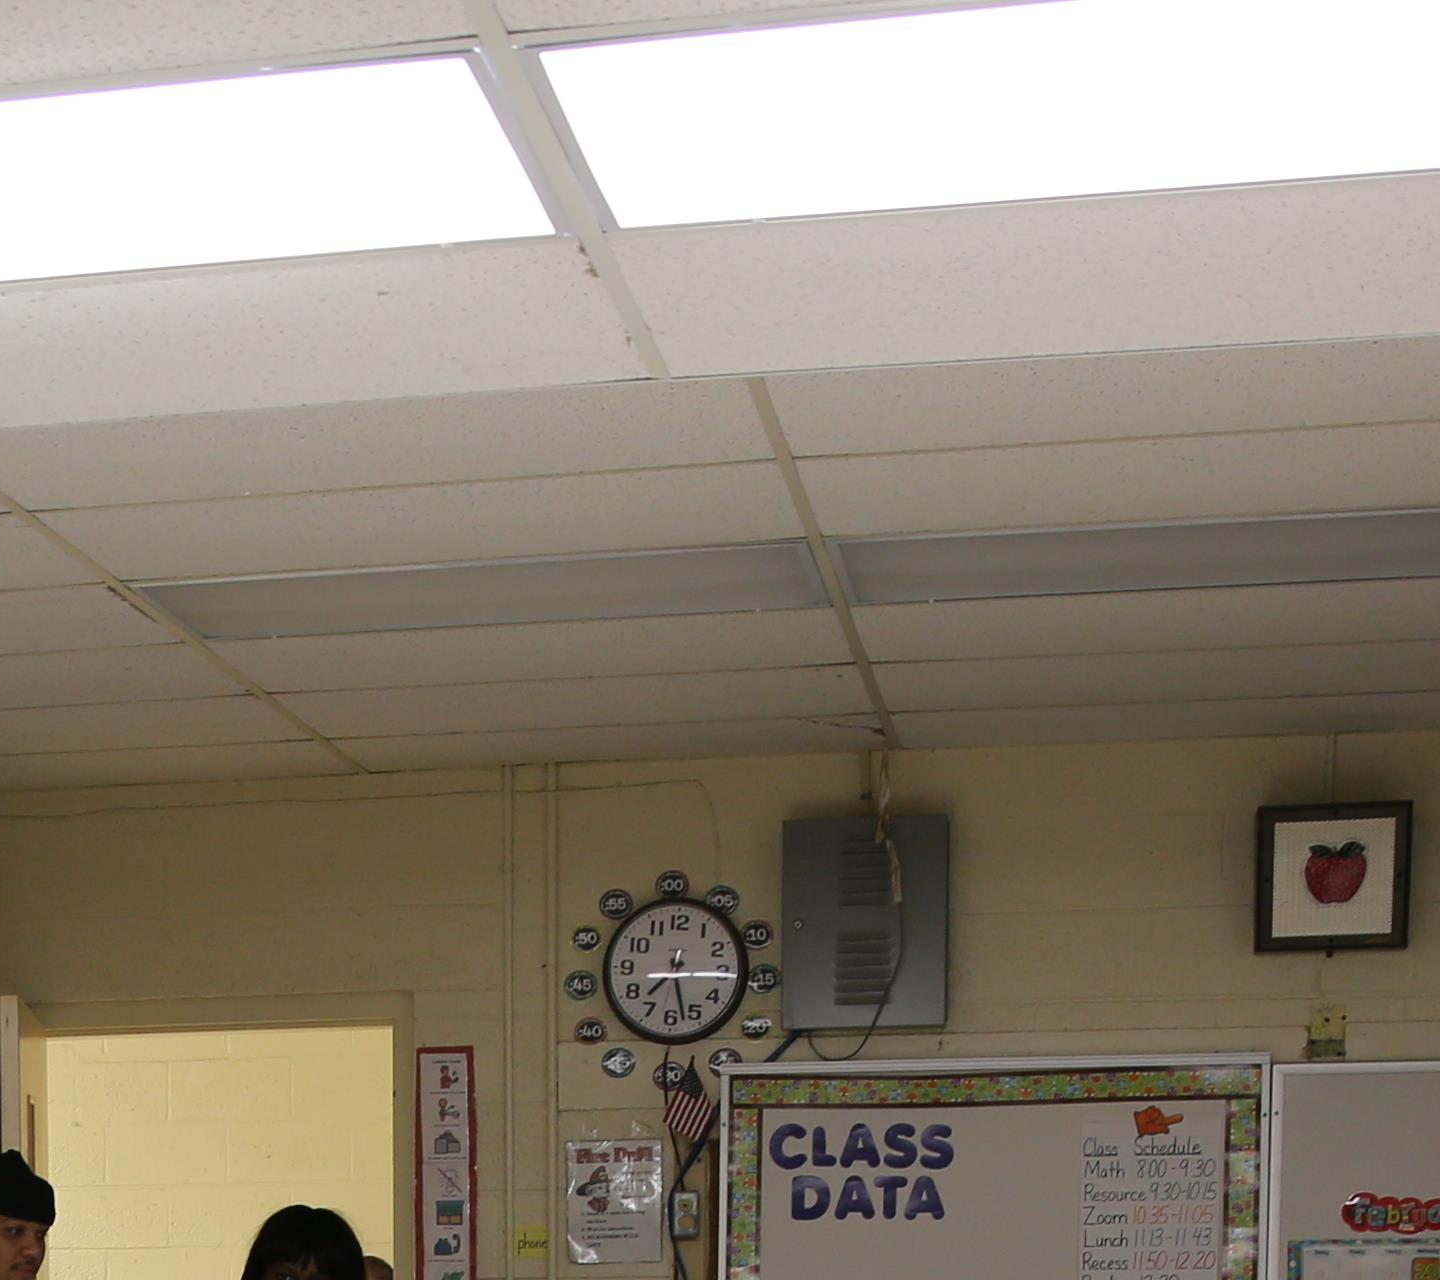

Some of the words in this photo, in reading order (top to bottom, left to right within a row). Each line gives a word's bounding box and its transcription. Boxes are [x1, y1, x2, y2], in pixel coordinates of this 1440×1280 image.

[660, 879, 682, 891] :00
[650, 920, 664, 936] 11
[670, 914, 690, 931] 12
[700, 922, 706, 938] 1
[630, 937, 650, 954] 10
[711, 941, 724, 957] 2
[620, 960, 634, 976] 9
[626, 984, 640, 999] 8
[705, 989, 720, 1004] 4
[643, 1002, 656, 1017] 7
[664, 1009, 677, 1025] 6
[687, 1004, 702, 1020] 5
[769, 1122, 955, 1169] CLASS
[1083, 1137, 1118, 1157] Class
[1133, 1136, 1202, 1156] Schedule
[576, 1148, 610, 1164] Fire
[1084, 1160, 1126, 1178] Math
[1136, 1158, 1216, 1178] 800-930
[790, 1175, 946, 1221] DATA
[1083, 1183, 1146, 1202] Resource
[1150, 1181, 1219, 1201] 930-1015
[1083, 1206, 1128, 1225] Zoom
[1133, 1203, 1215, 1225] 1035-1105
[517, 1231, 548, 1256] phone
[1083, 1229, 1128, 1248] Lunch
[1134, 1227, 1212, 1247] 1113-1143
[1082, 1251, 1128, 1271] Recess
[1132, 1250, 1216, 1270] 1150-1220
